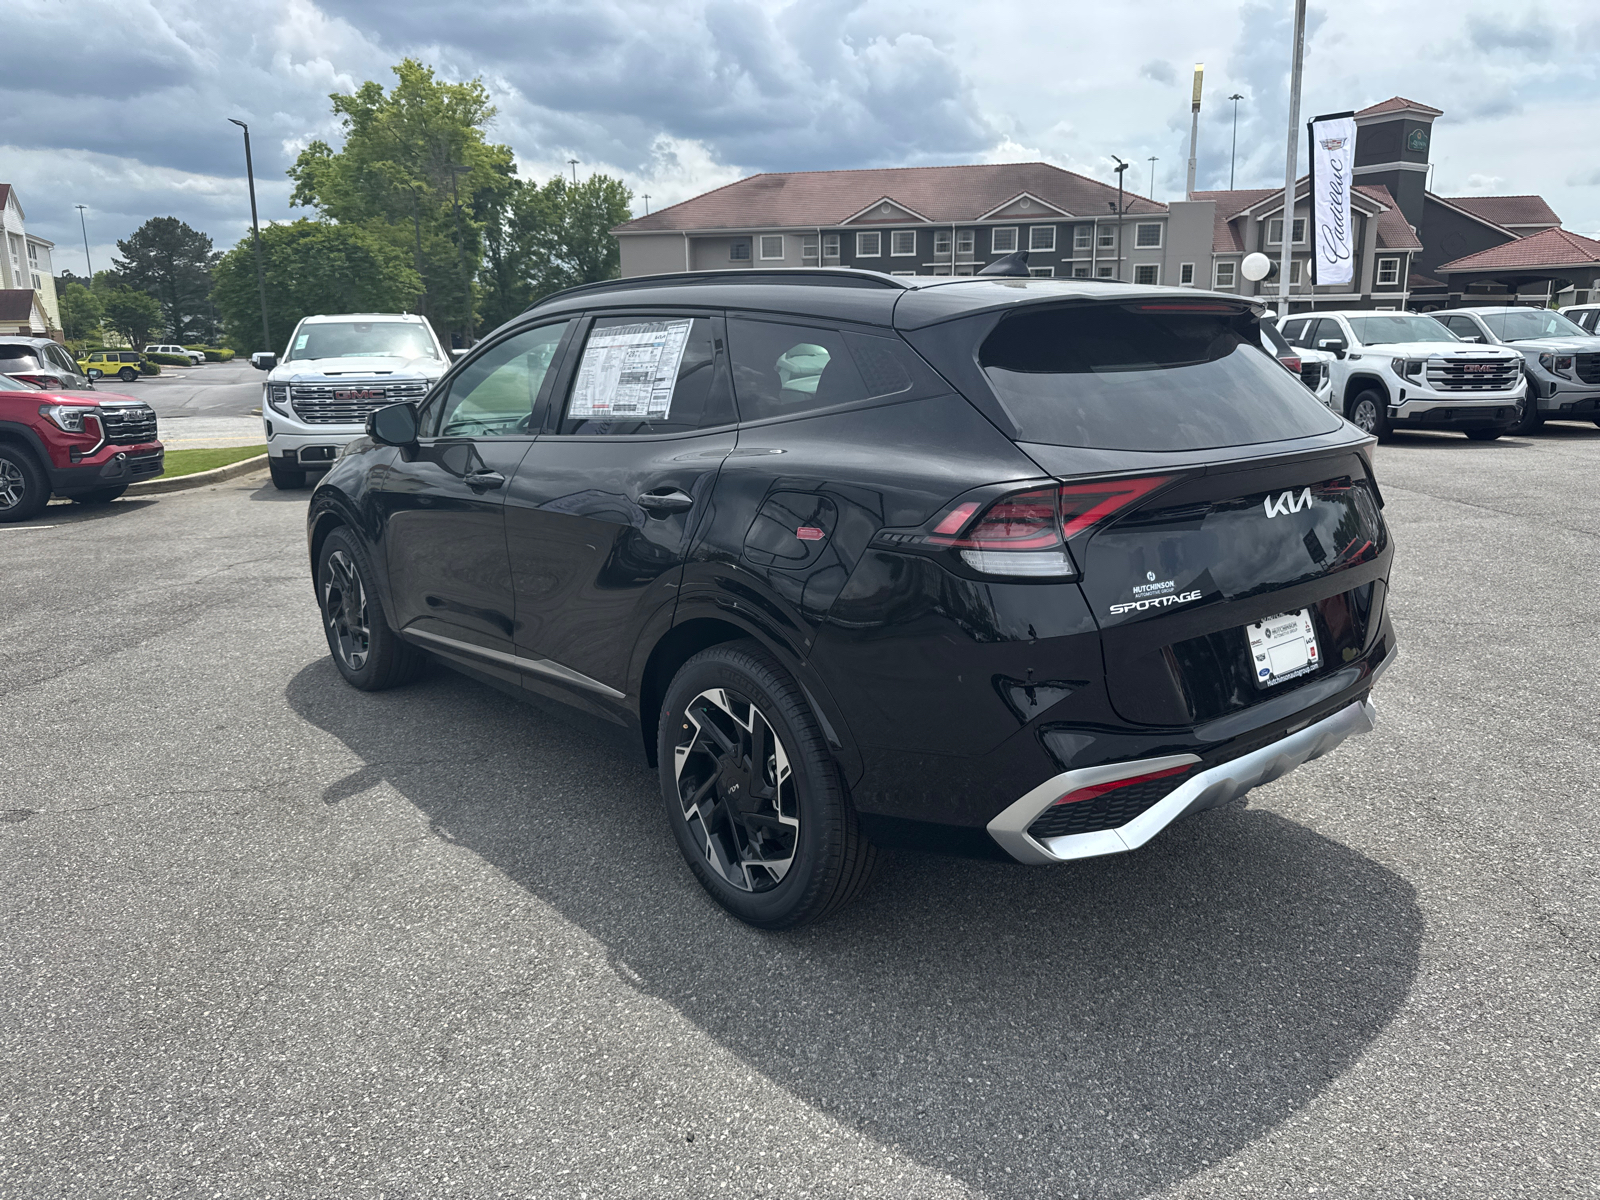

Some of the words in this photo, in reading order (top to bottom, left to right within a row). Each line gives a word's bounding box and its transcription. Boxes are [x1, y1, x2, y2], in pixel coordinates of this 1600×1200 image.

[1322, 158, 1350, 264] Cadillac
[1463, 364, 1498, 373] GMC
[335, 389, 385, 400] GMC
[1264, 487, 1313, 519] KIA
[1132, 580, 1175, 594] HUTCHINSON
[1135, 589, 1161, 598] AUTOMOTIVE
[1109, 589, 1203, 615] SPORTAGE
[1271, 620, 1298, 635] HUTCHINSON
